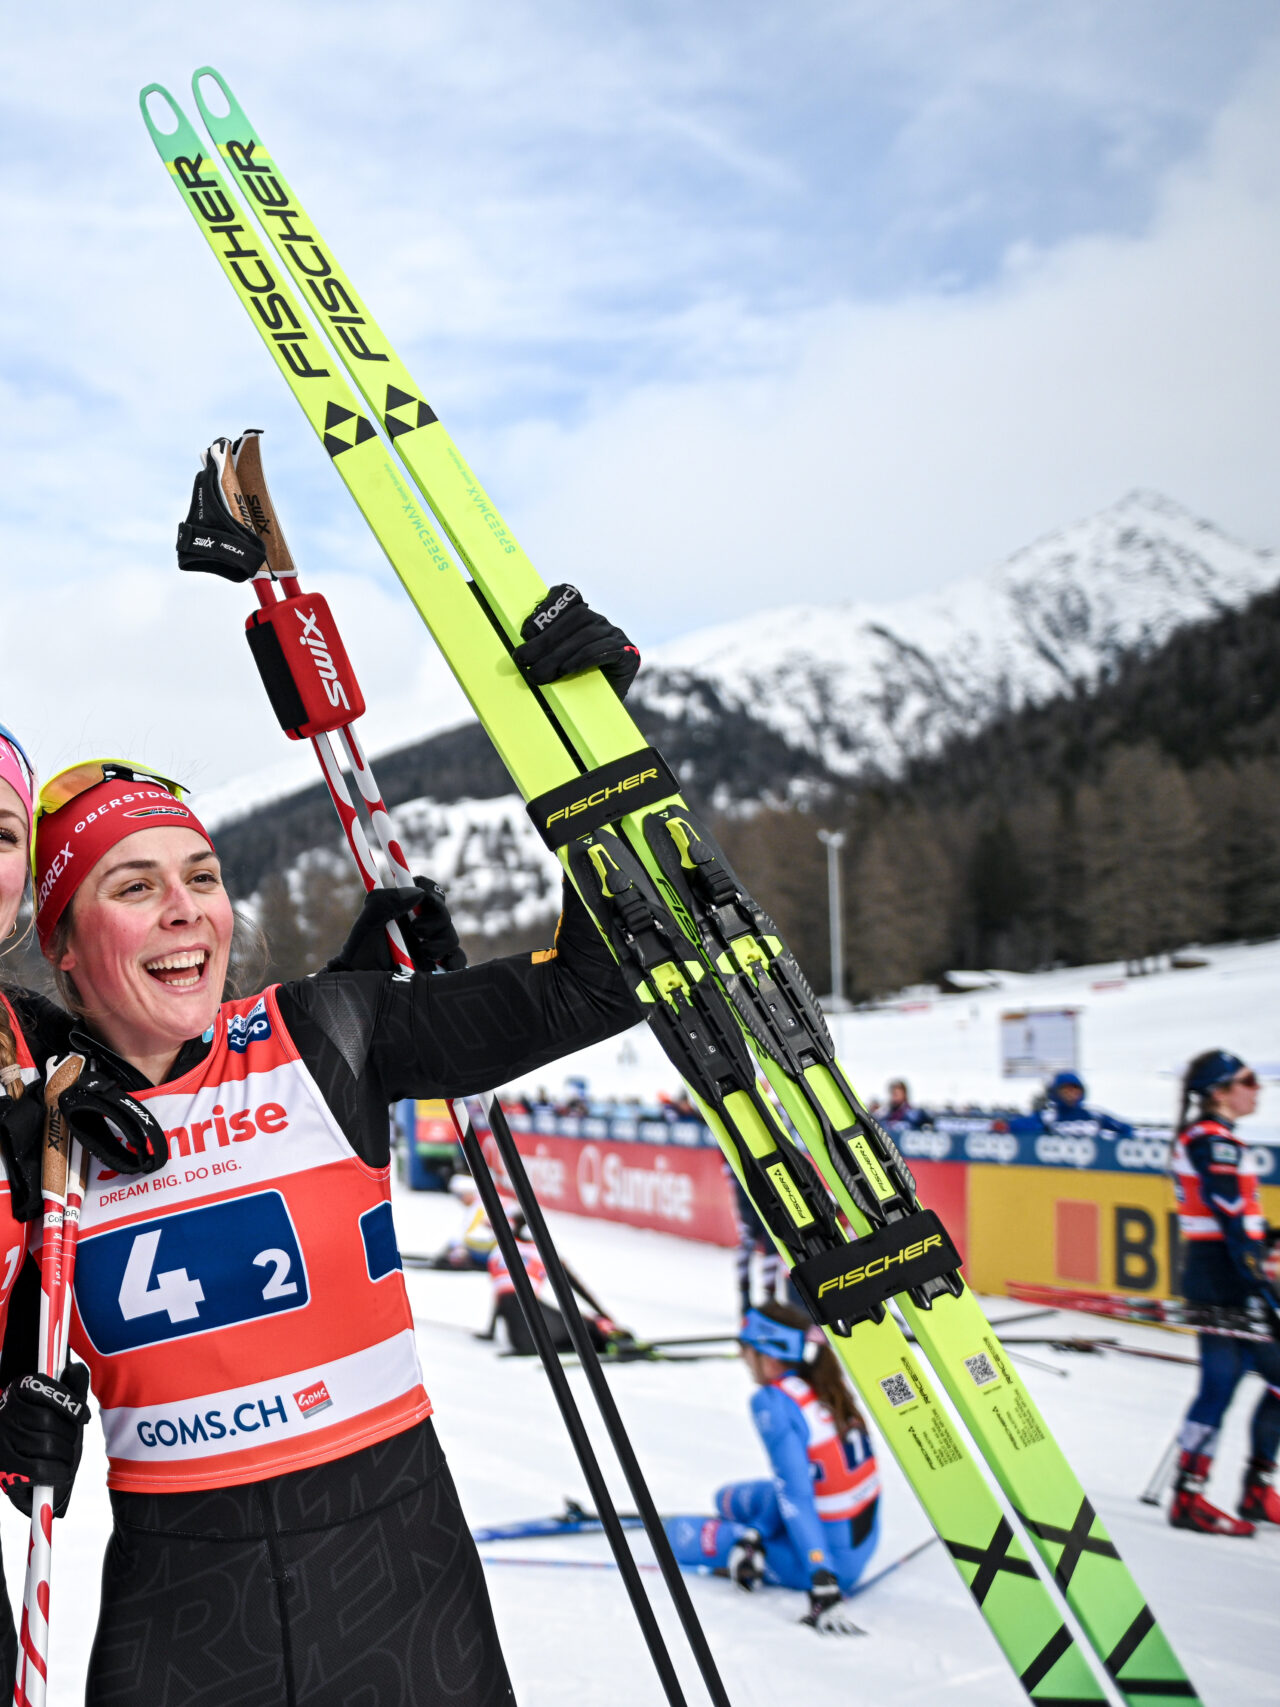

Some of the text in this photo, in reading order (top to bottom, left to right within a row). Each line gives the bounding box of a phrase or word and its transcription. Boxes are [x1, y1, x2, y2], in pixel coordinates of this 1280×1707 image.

[173, 152, 331, 378] FISCHER
[227, 138, 390, 362] FISCHER
[546, 767, 659, 829] FISCHER
[99, 1159, 243, 1208] DREAM BIG. DO BIG.
[603, 1153, 694, 1224] Sunrise
[778, 1176, 806, 1219] FISCHER
[860, 1150, 887, 1192] FISCHER
[118, 1229, 206, 1324] 4
[252, 1248, 298, 1300] 2
[818, 1234, 943, 1299] FISCHER
[137, 1395, 288, 1447] GOMS.CH
